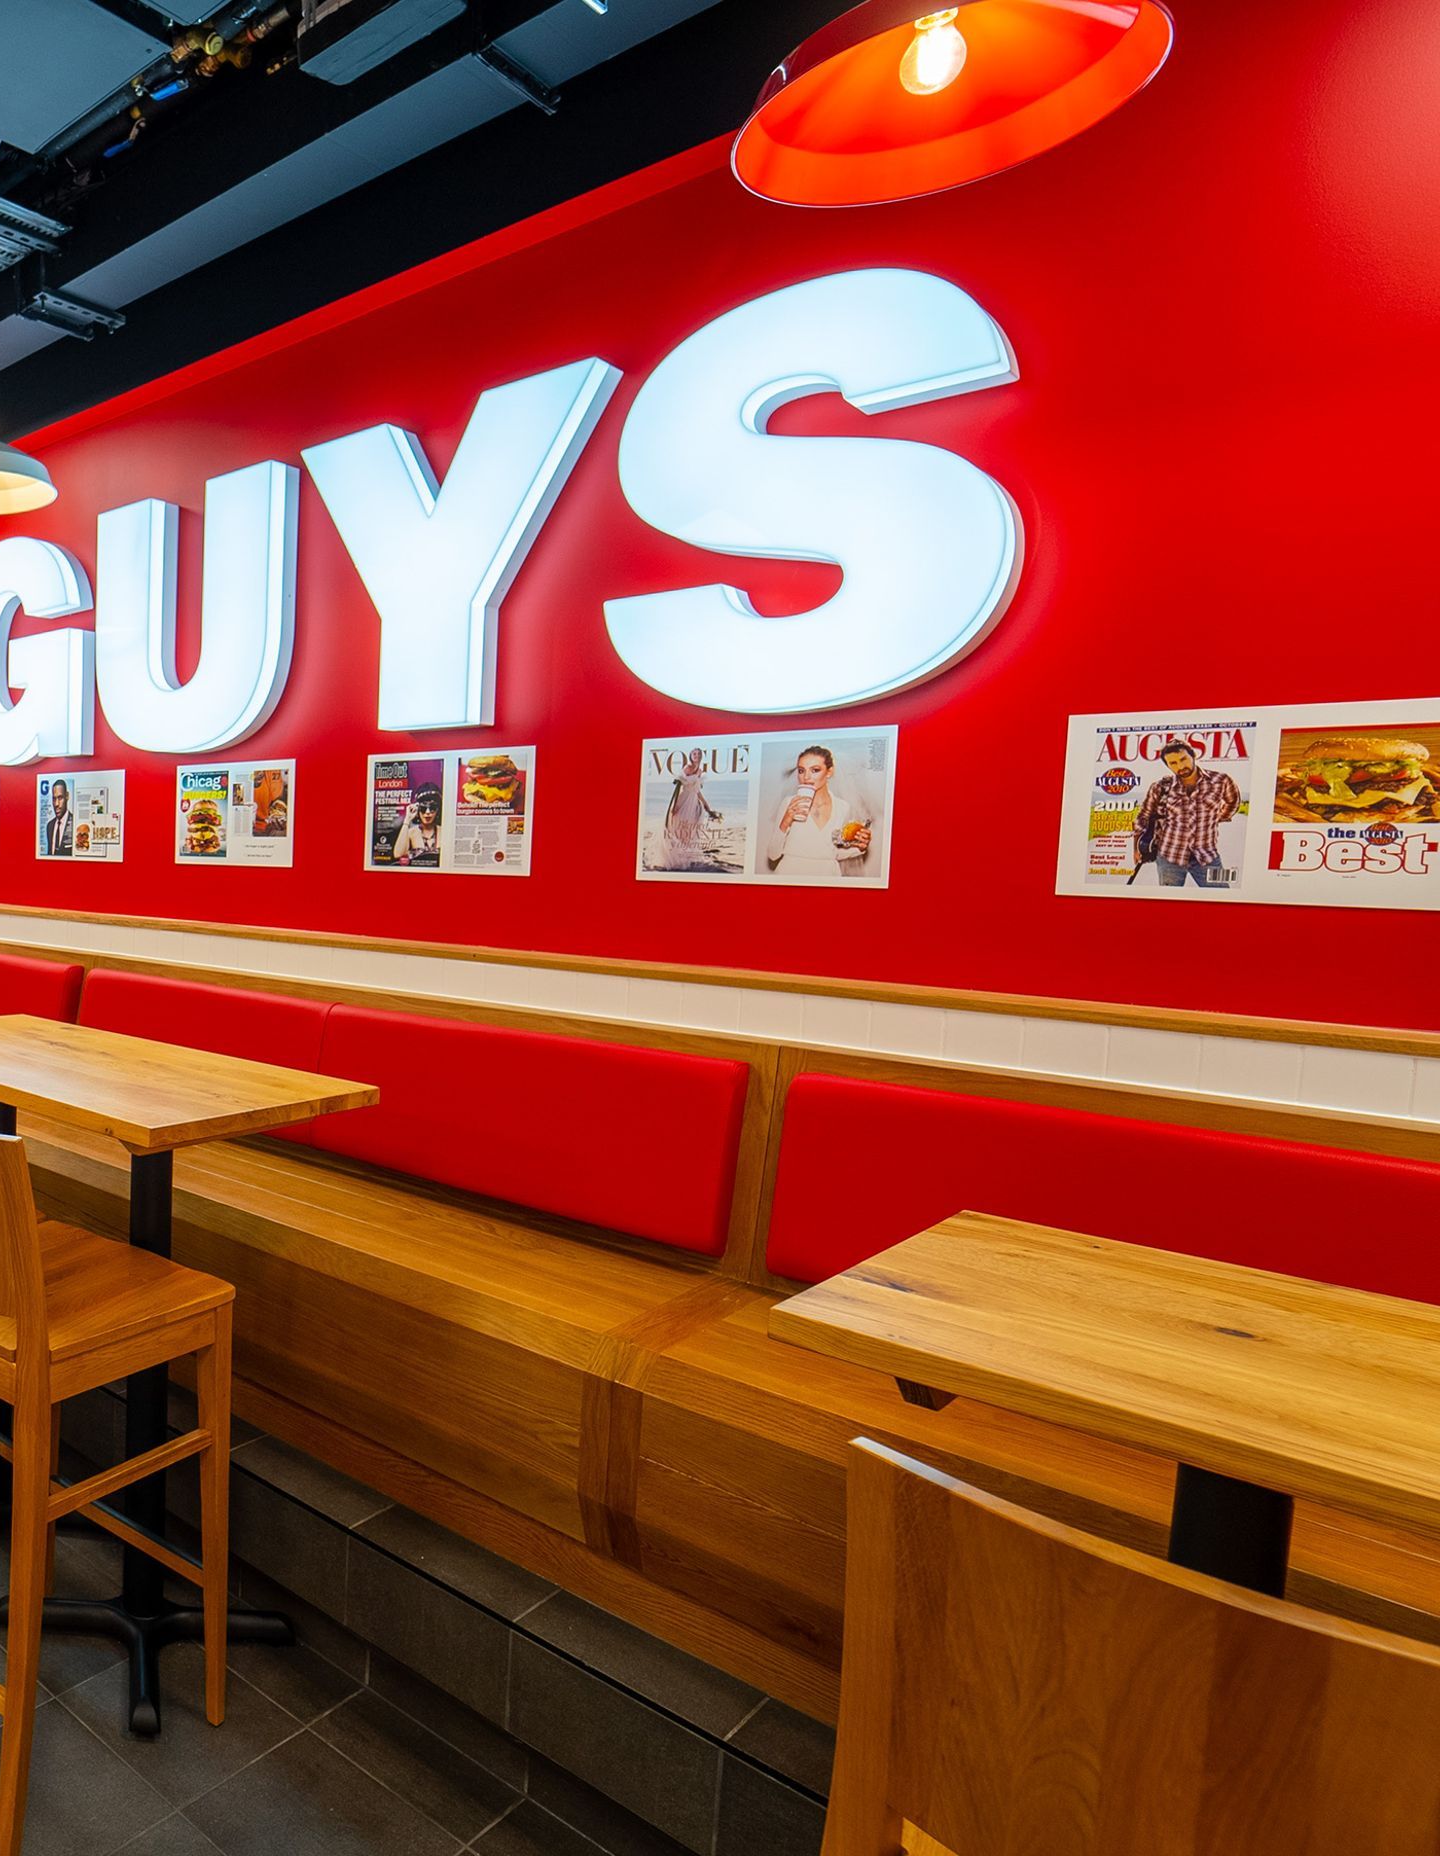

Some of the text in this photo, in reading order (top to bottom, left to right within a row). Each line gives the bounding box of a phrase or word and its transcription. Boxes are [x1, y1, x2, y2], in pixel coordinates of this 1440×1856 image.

[1106, 769, 1127, 778] Best
[378, 780, 403, 788] London
[375, 789, 412, 798] THE PERFECT
[1107, 785, 1130, 793] 2010
[375, 797, 400, 805] FESTIVAL
[1095, 800, 1134, 812] 2010
[1093, 812, 1133, 821] Best of
[1091, 821, 1134, 832] AUGUSTA
[1327, 827, 1356, 838] the
[1279, 831, 1428, 874] Best
